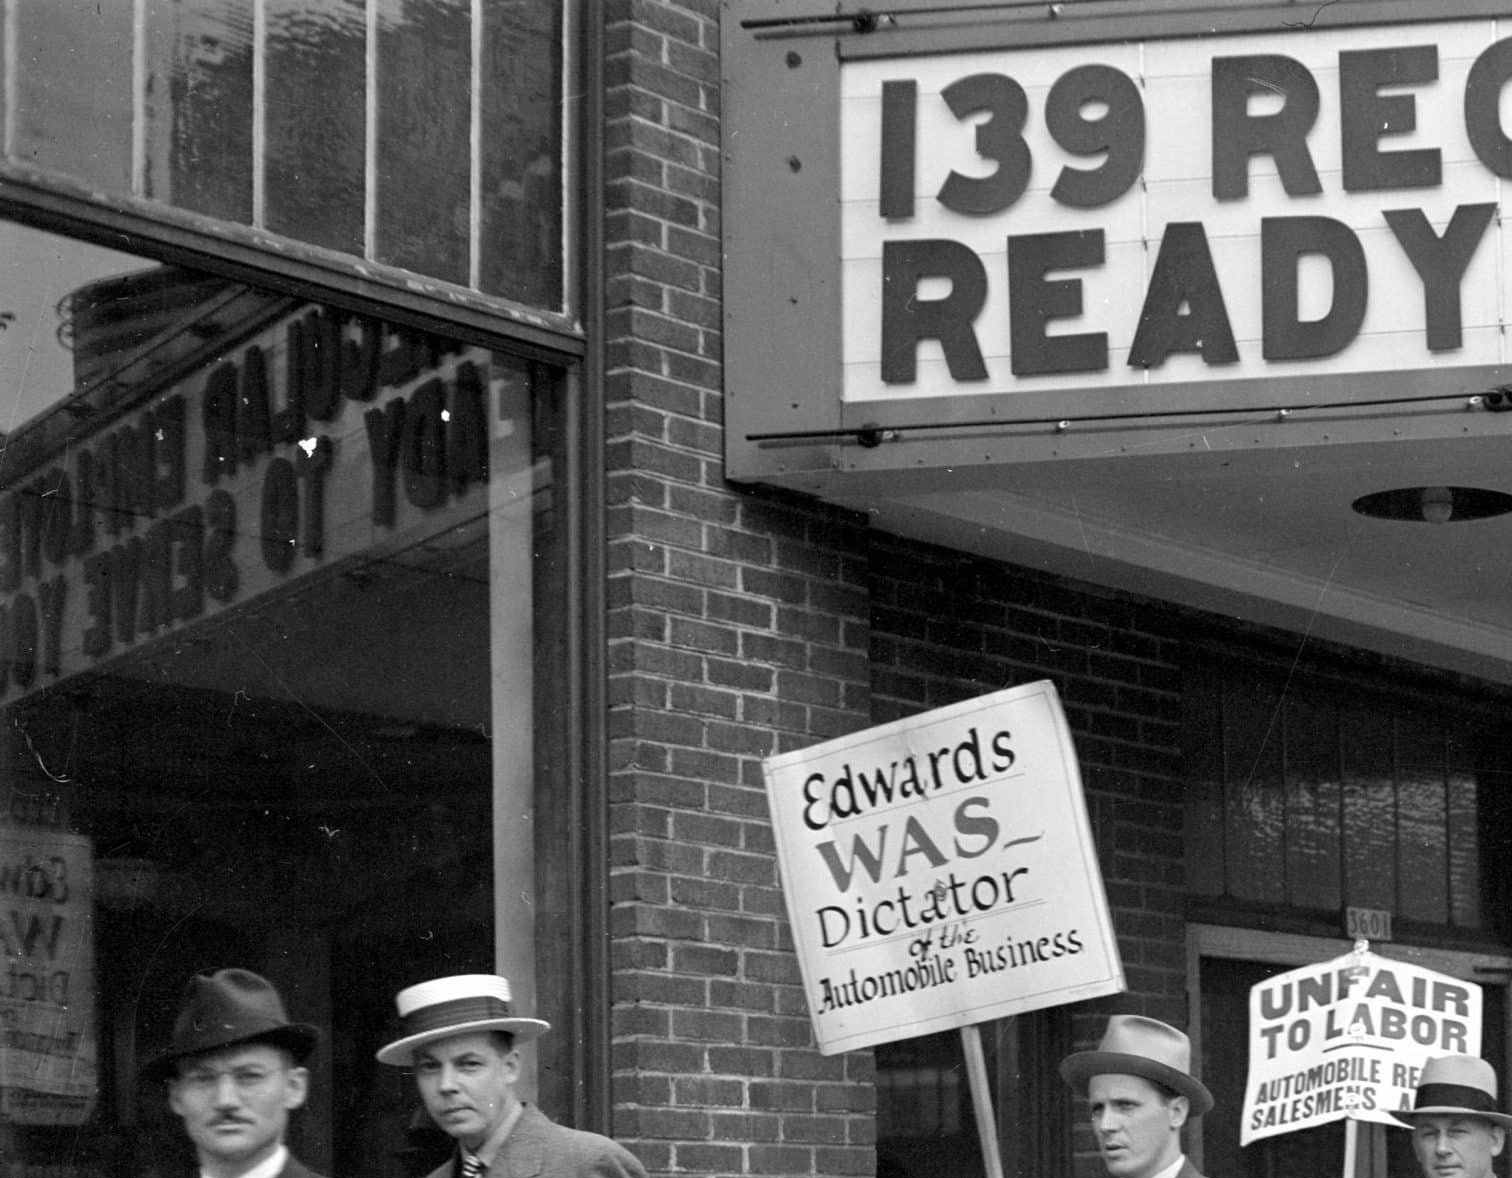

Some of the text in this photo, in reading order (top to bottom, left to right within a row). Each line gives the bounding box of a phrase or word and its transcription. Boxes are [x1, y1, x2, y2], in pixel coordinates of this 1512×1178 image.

[880, 63, 1146, 222] 139
[880, 202, 1499, 384] READY
[802, 727, 1016, 831] Edwards
[816, 866, 1029, 948] Dictator
[908, 920, 980, 961] of the
[818, 929, 1084, 1015] Automobile Business
[1260, 966, 1470, 1021] UNFAIR
[1260, 1003, 1468, 1060] TO LABOR
[1255, 1057, 1424, 1105] AUTOMOBILE RE
